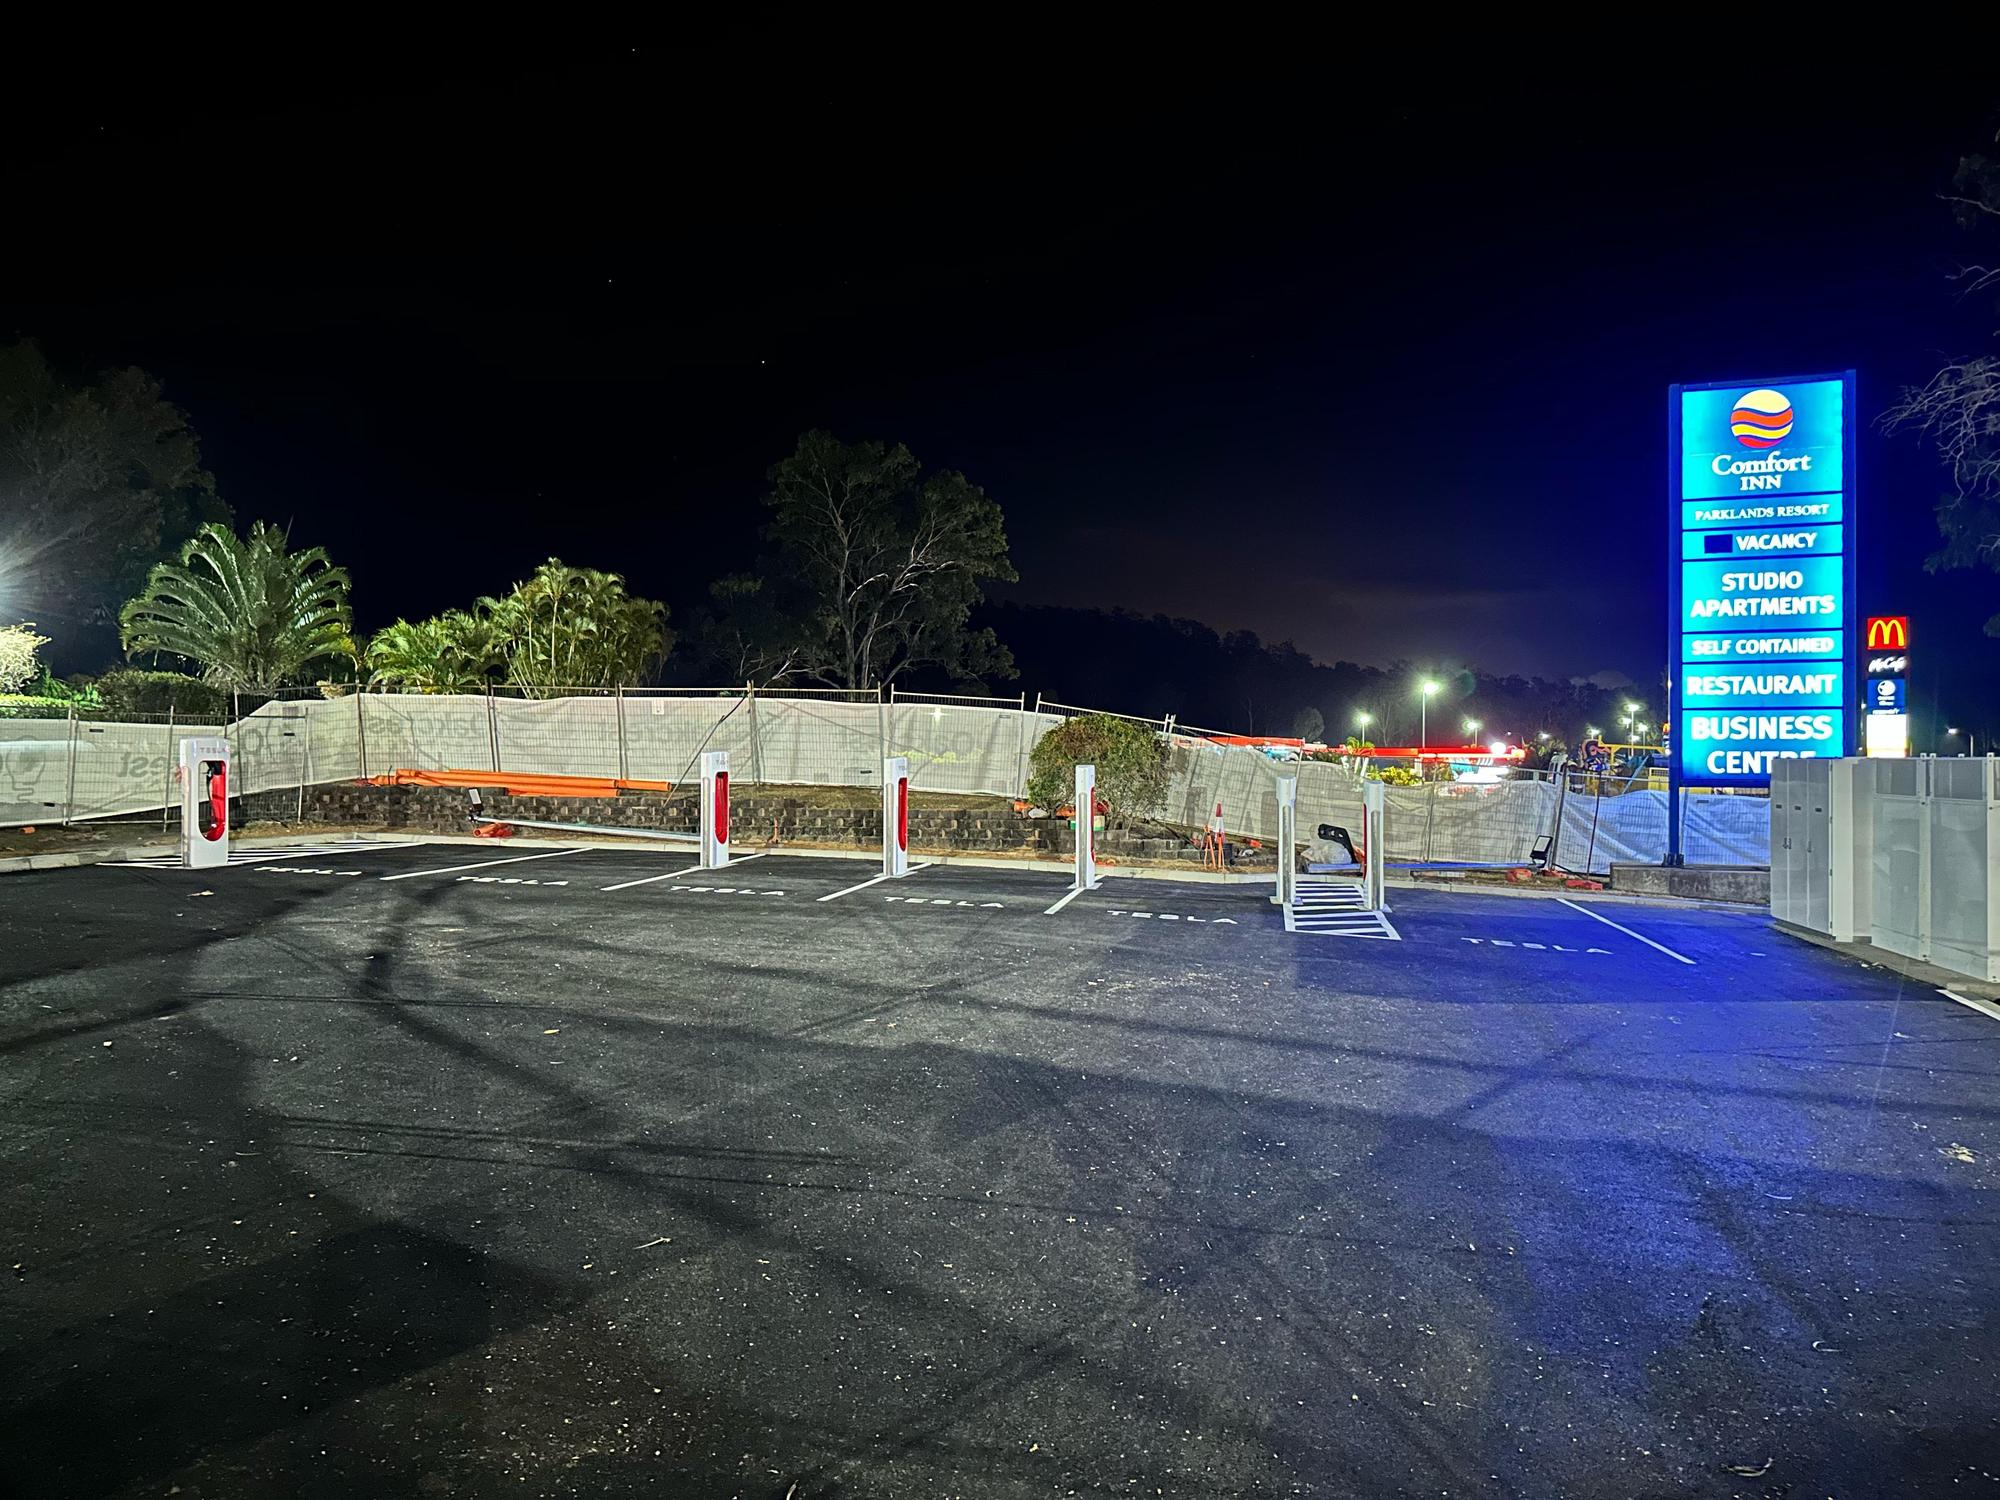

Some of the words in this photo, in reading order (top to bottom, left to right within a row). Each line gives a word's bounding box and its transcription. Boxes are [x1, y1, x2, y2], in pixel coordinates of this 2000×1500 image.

[1711, 450, 1812, 476] Comfort
[1740, 474, 1782, 491] INN
[1694, 506, 1775, 521] PARKLANDS
[1777, 503, 1830, 518] RESORT
[1735, 531, 1817, 551] VACANCY
[1721, 570, 1804, 592] STUDIO
[1689, 594, 1836, 618] APARTMENTS
[1691, 638, 1732, 656] SELF
[1735, 636, 1835, 655] CONTAINED
[1686, 673, 1838, 697] RESTAURANT
[1690, 715, 1833, 741] BUSINESS
[1706, 750, 1817, 774] CENT
[669, 885, 785, 896] TESLA
[883, 895, 1005, 909] TESLA
[1106, 910, 1238, 925] TESLA
[1460, 937, 1614, 955] TESLA
